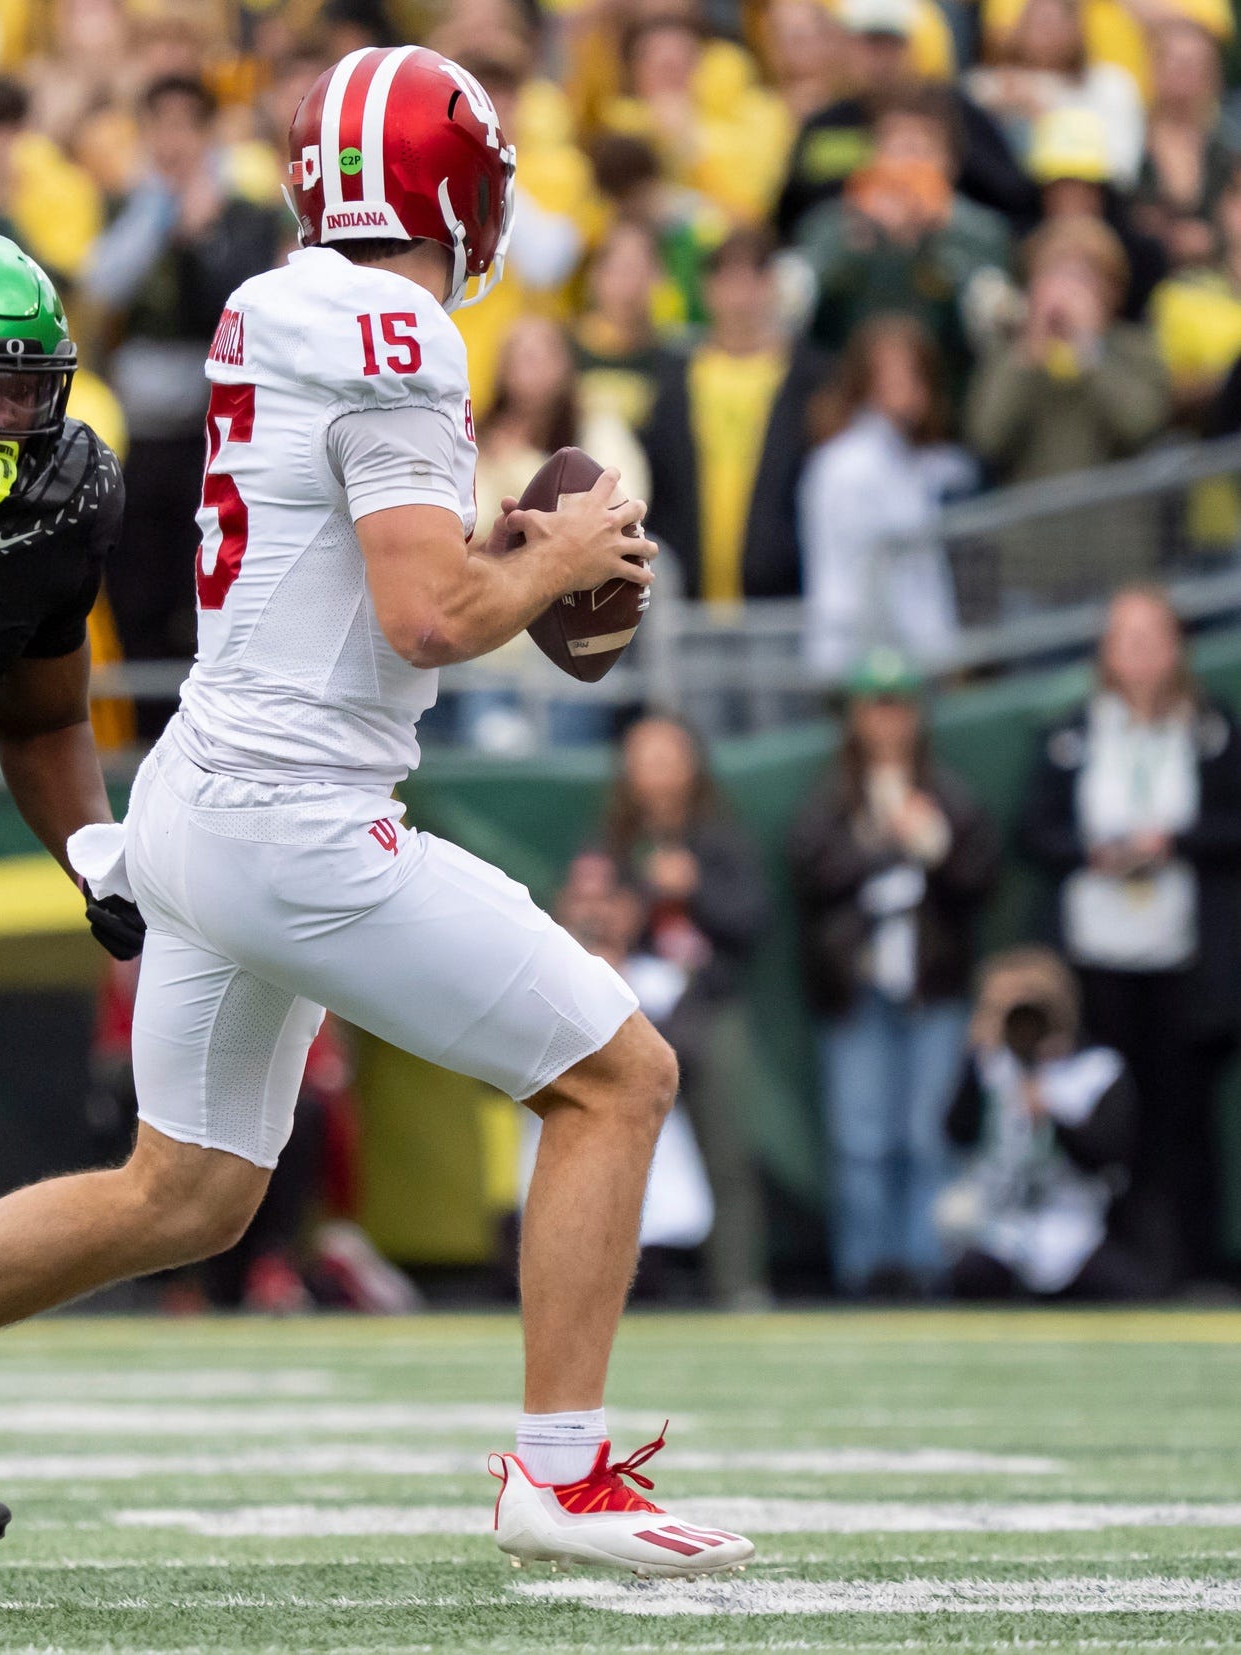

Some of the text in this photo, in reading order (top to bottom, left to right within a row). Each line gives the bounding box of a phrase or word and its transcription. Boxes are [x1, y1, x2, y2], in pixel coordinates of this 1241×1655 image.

[340, 155, 361, 166] C2P
[326, 211, 388, 229] INDIANA
[356, 313, 422, 376] 15
